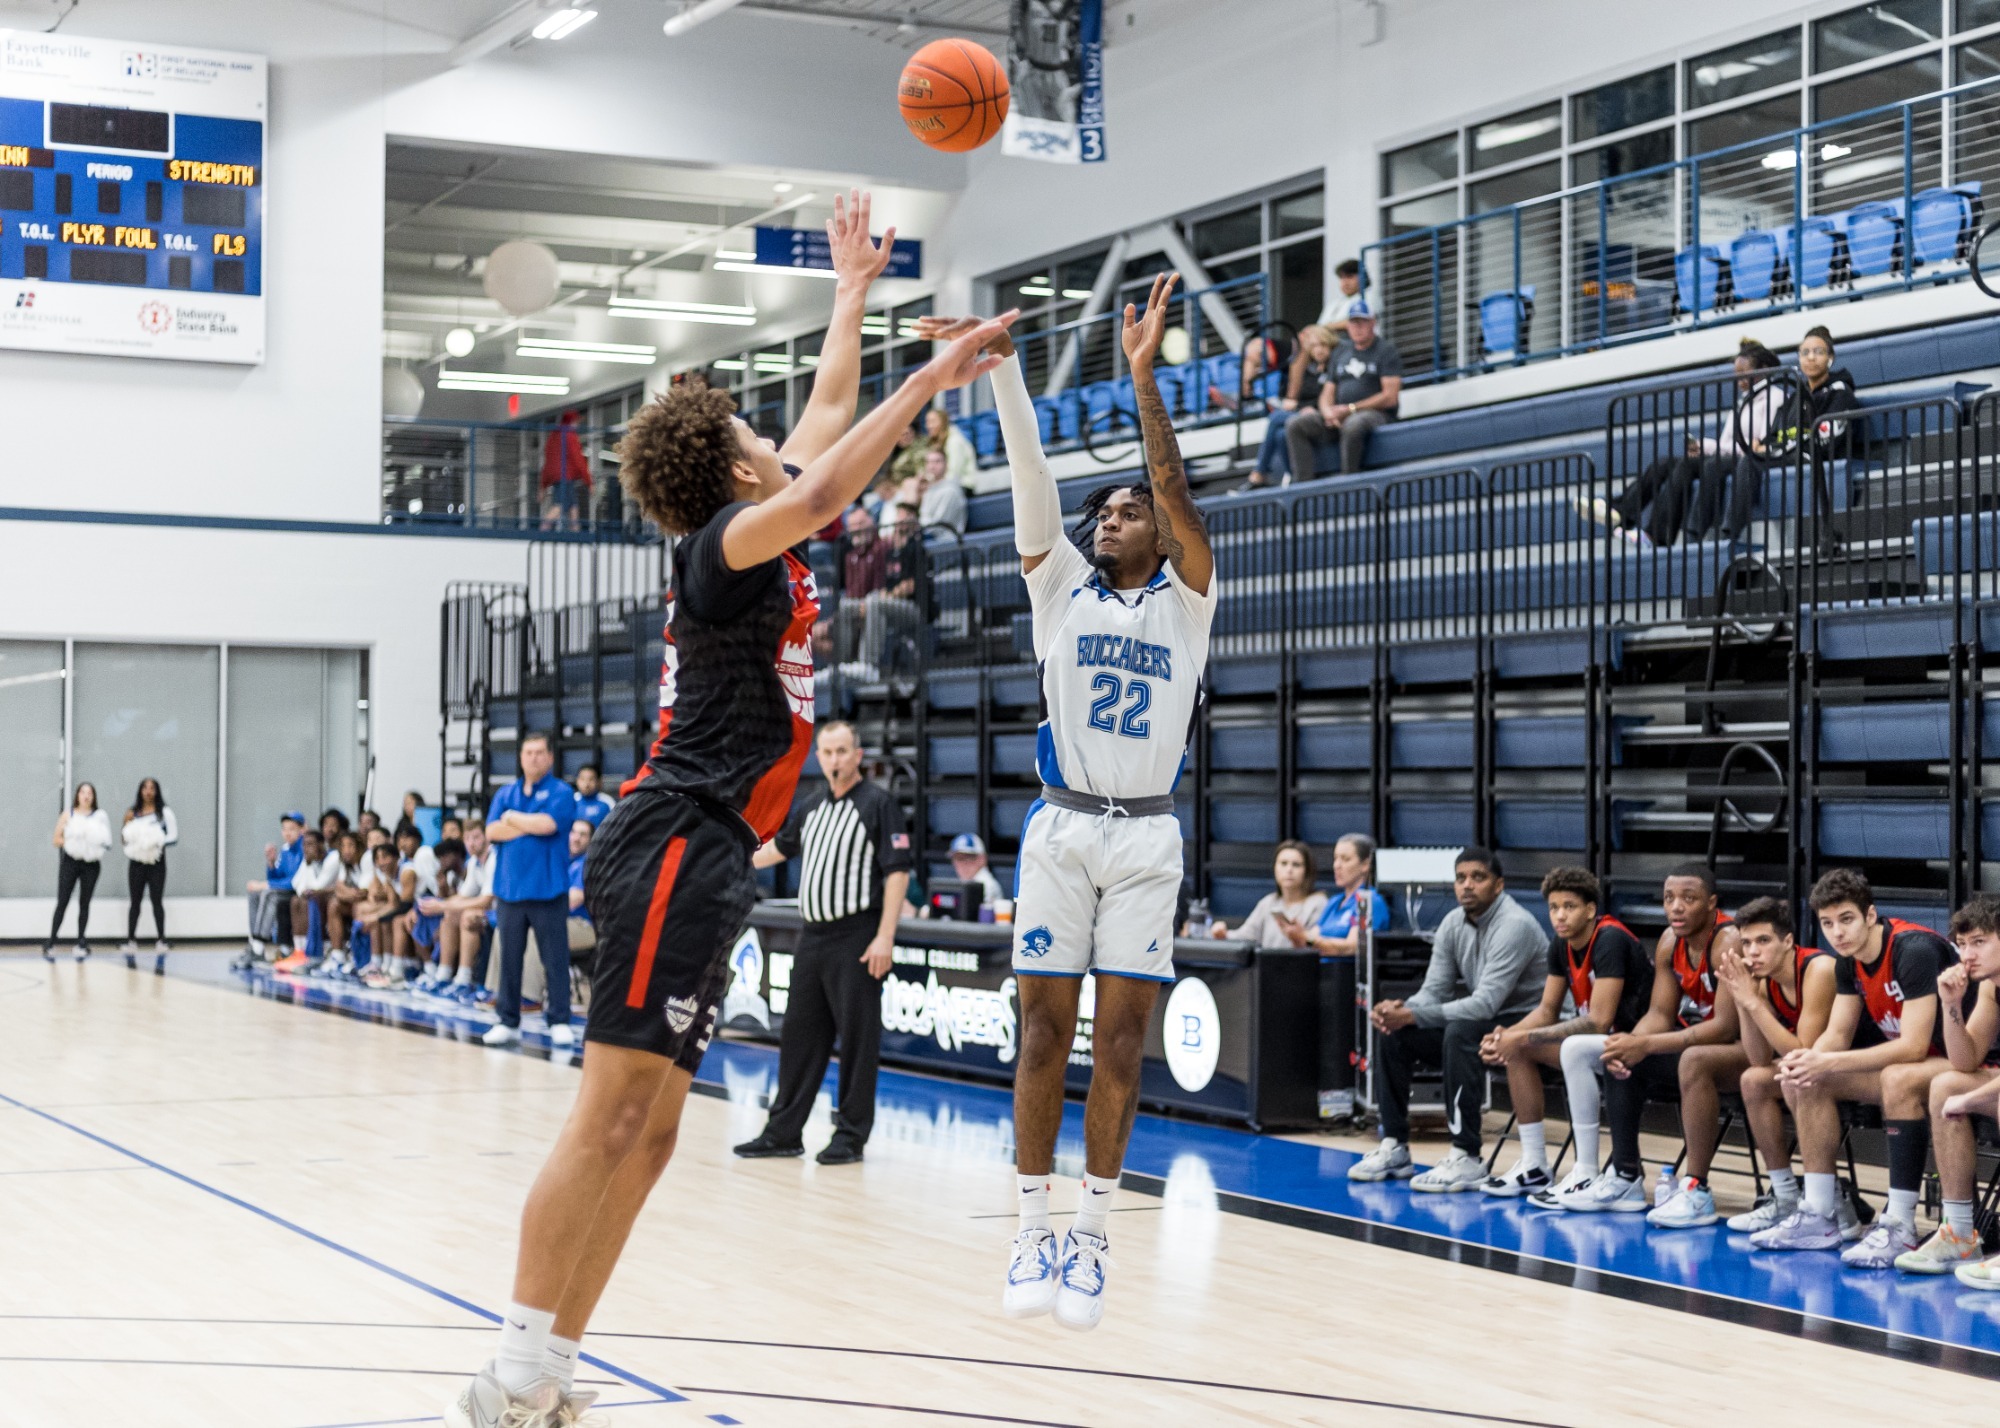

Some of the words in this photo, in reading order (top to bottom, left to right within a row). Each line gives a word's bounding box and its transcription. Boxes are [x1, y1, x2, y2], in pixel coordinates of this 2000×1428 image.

[7, 40, 91, 59] Fayetteville
[7, 54, 43, 68] Bank
[1081, 42, 1101, 124] SECTION
[1083, 129, 1101, 160] 3
[86, 162, 134, 181] PERIOD
[169, 159, 254, 187] STRENGTH
[62, 222, 106, 246] PLYR
[114, 226, 157, 250] FOUL
[213, 233, 246, 256] FLS
[176, 308, 226, 322] Industry
[176, 321, 205, 332] State
[209, 323, 238, 334] Bank
[1087, 671, 1152, 739] 22
[928, 949, 979, 971] COLLEGE
[1181, 1014, 1201, 1048] B
